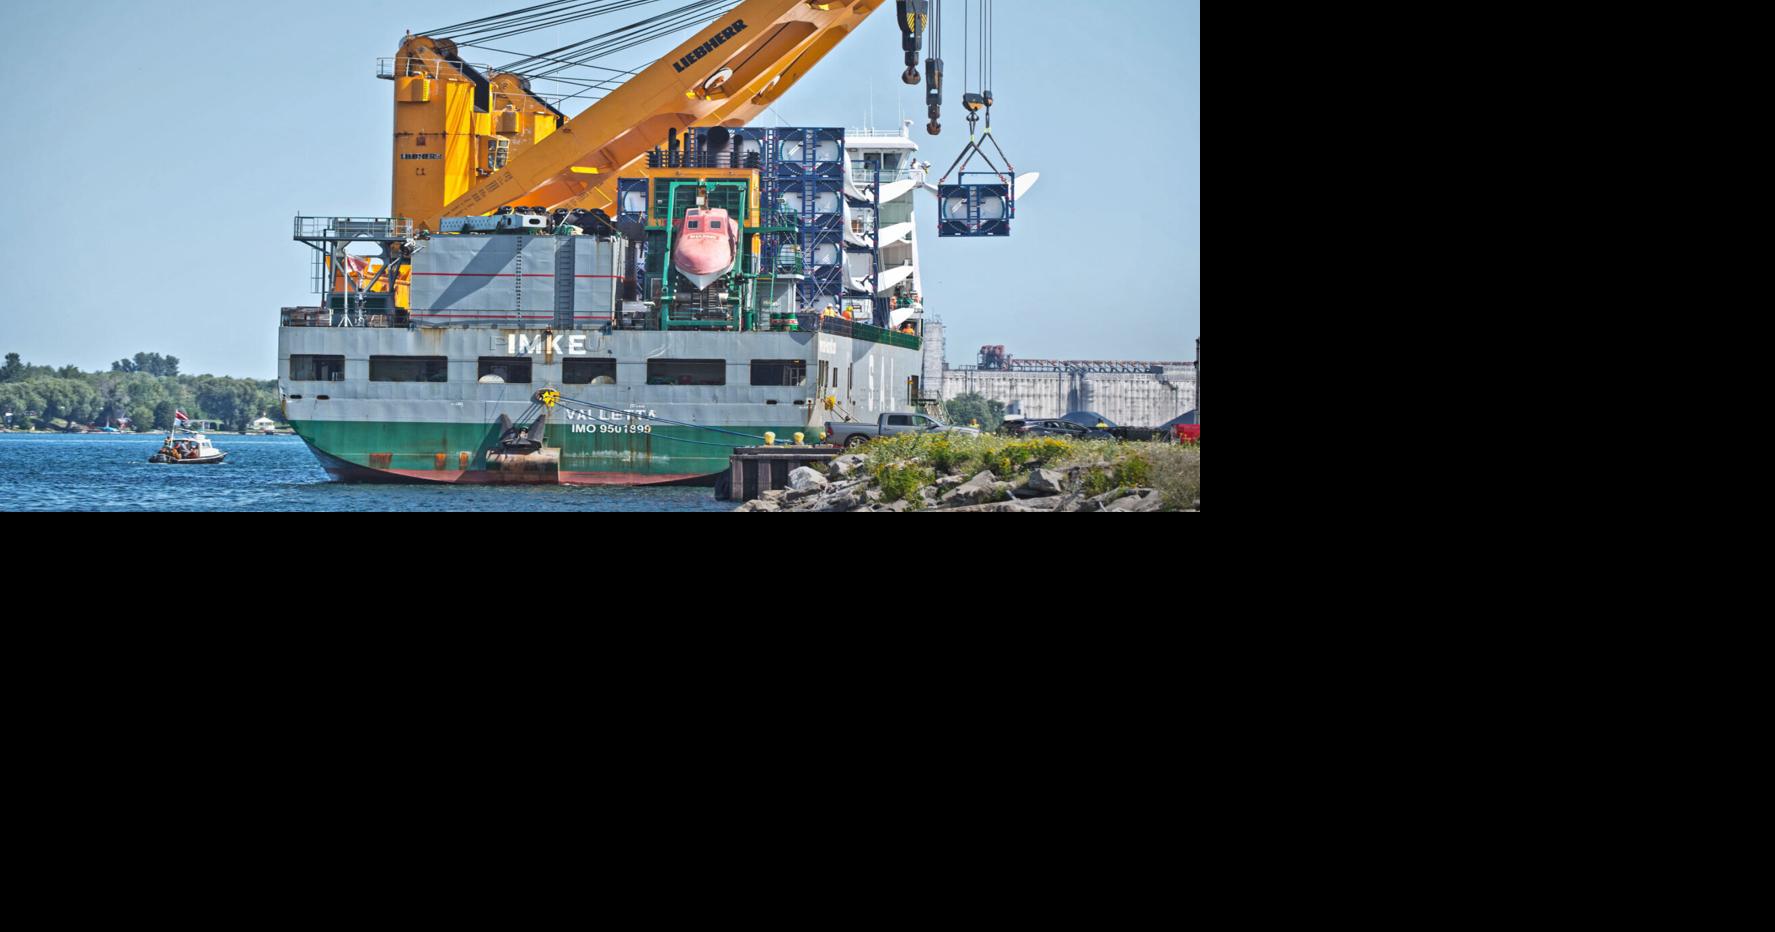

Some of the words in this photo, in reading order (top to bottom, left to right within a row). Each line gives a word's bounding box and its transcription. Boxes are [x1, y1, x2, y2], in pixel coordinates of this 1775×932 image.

[672, 19, 748, 73] LIEBHERR
[508, 333, 587, 355] IMKE
[566, 409, 657, 421] VALLETTA
[571, 419, 597, 433] IMO
[600, 419, 652, 434] 9501899
